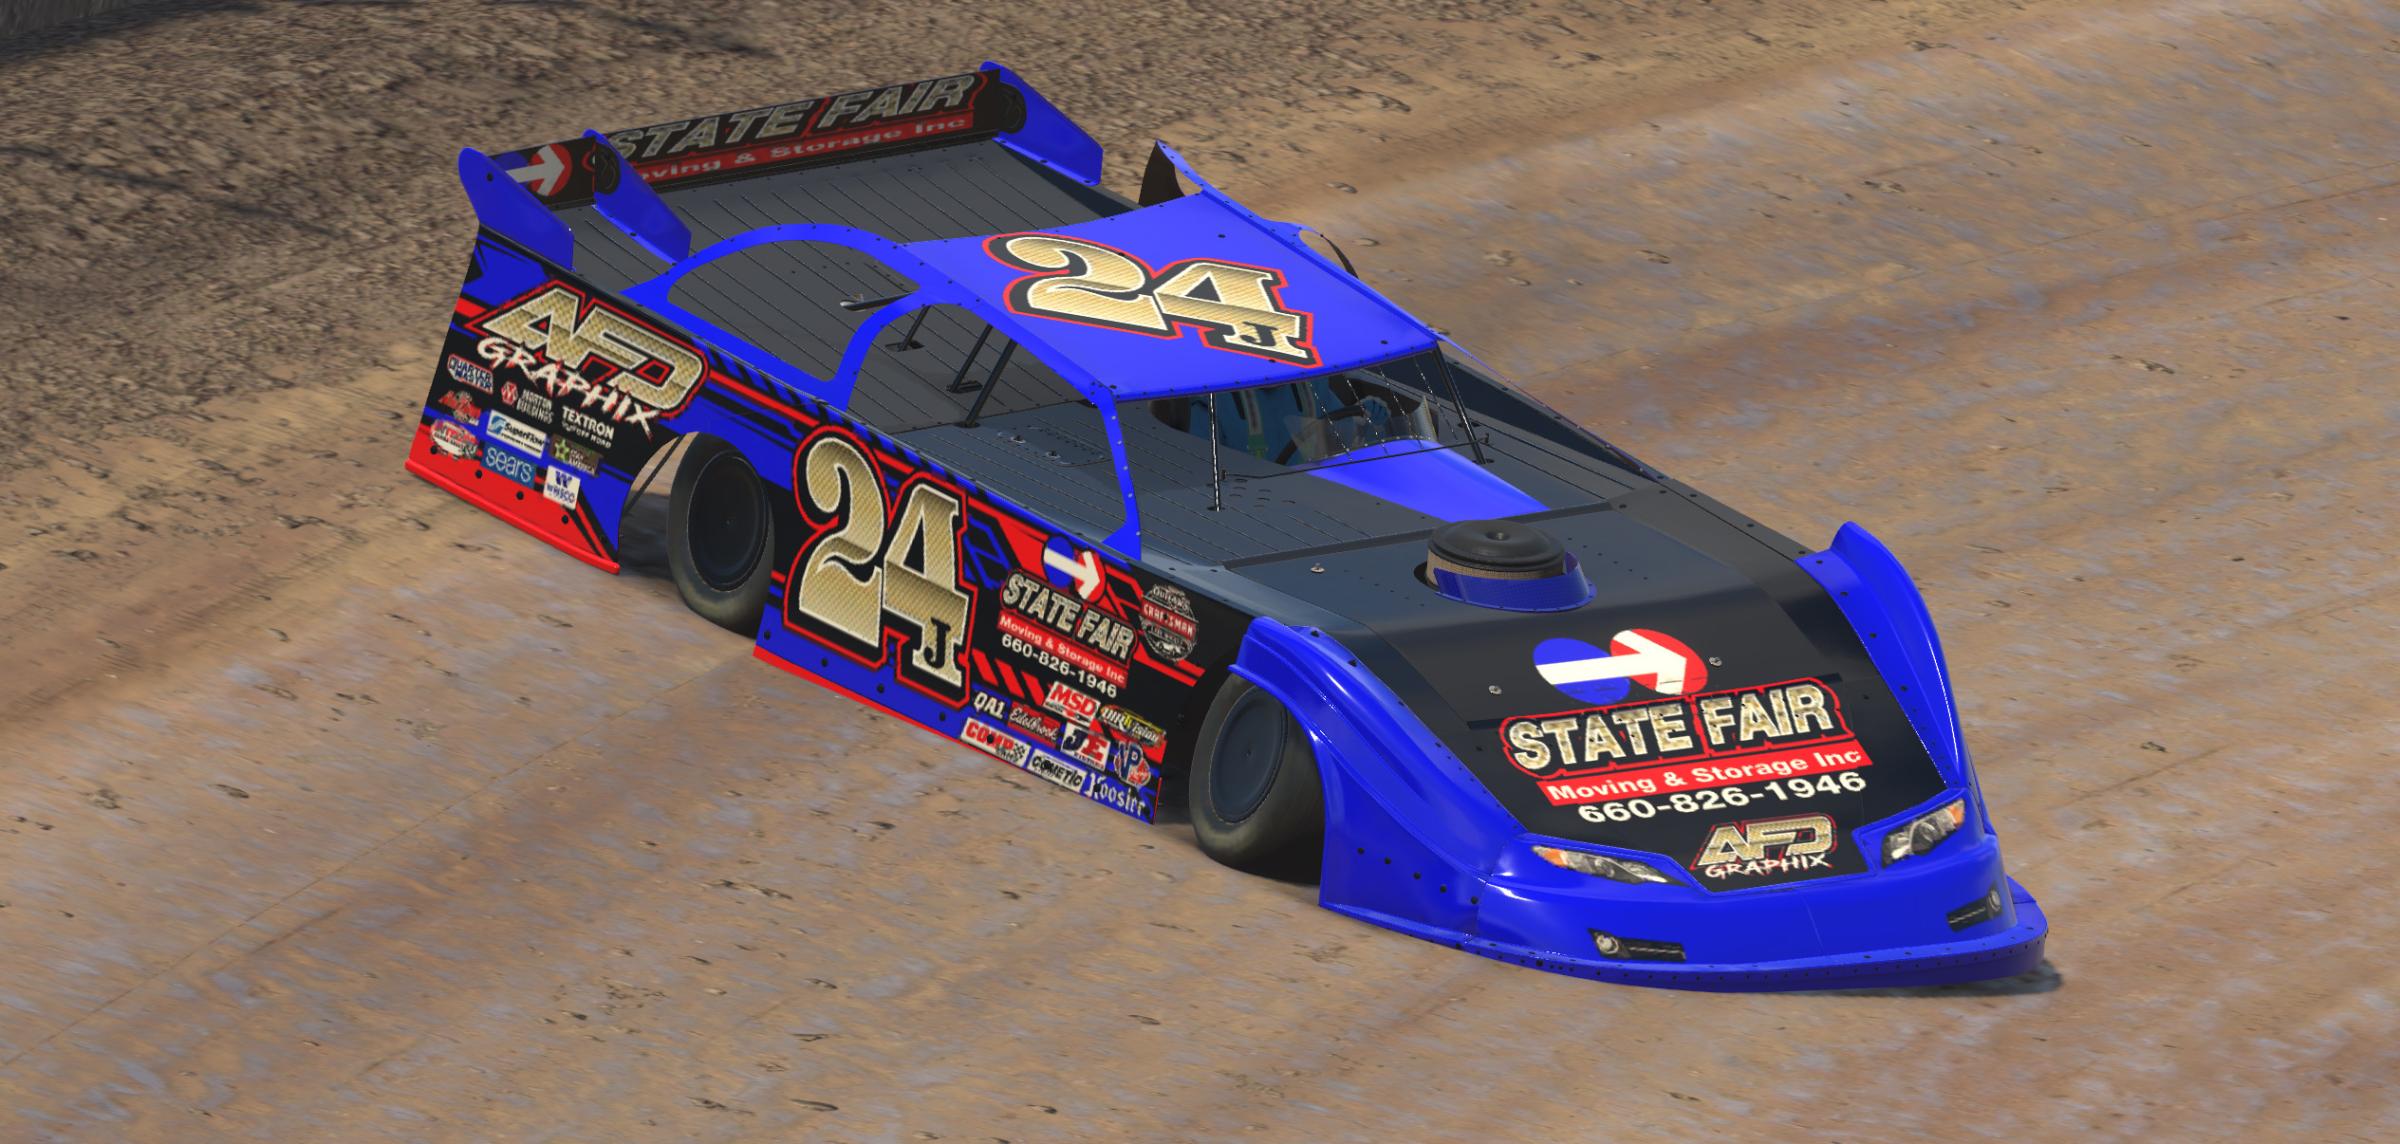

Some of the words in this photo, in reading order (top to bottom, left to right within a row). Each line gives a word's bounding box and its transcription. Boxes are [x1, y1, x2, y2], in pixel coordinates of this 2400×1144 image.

[606, 101, 813, 160] STATE
[817, 75, 975, 129] FAIR
[734, 150, 757, 164] &
[770, 129, 902, 159] Storage
[915, 116, 968, 135] Inc
[481, 287, 703, 411] AFD
[477, 336, 662, 441] GRAPHIX
[562, 405, 615, 440] TEXTRON
[485, 447, 532, 483] sears
[1002, 573, 1081, 632] STATE
[1077, 609, 1135, 660] FAIR
[1000, 615, 1043, 646] Moving
[1045, 638, 1054, 650] &
[1057, 643, 1104, 672] Storage
[1106, 663, 1125, 683] Inc
[1001, 633, 1117, 698] 660-826-1946
[973, 691, 1005, 719] QA1
[1049, 683, 1098, 716] MSD
[1508, 702, 1694, 770] STATE
[1700, 683, 1834, 746] FAIR
[1547, 775, 1657, 801] Moving
[1663, 771, 1688, 788] &
[1691, 755, 1808, 784] Storage
[1814, 750, 1863, 768] Inc
[1577, 771, 1867, 824] 660-826-1946
[1697, 814, 1833, 866] AFD
[1704, 854, 1834, 879] GRAPHIX
